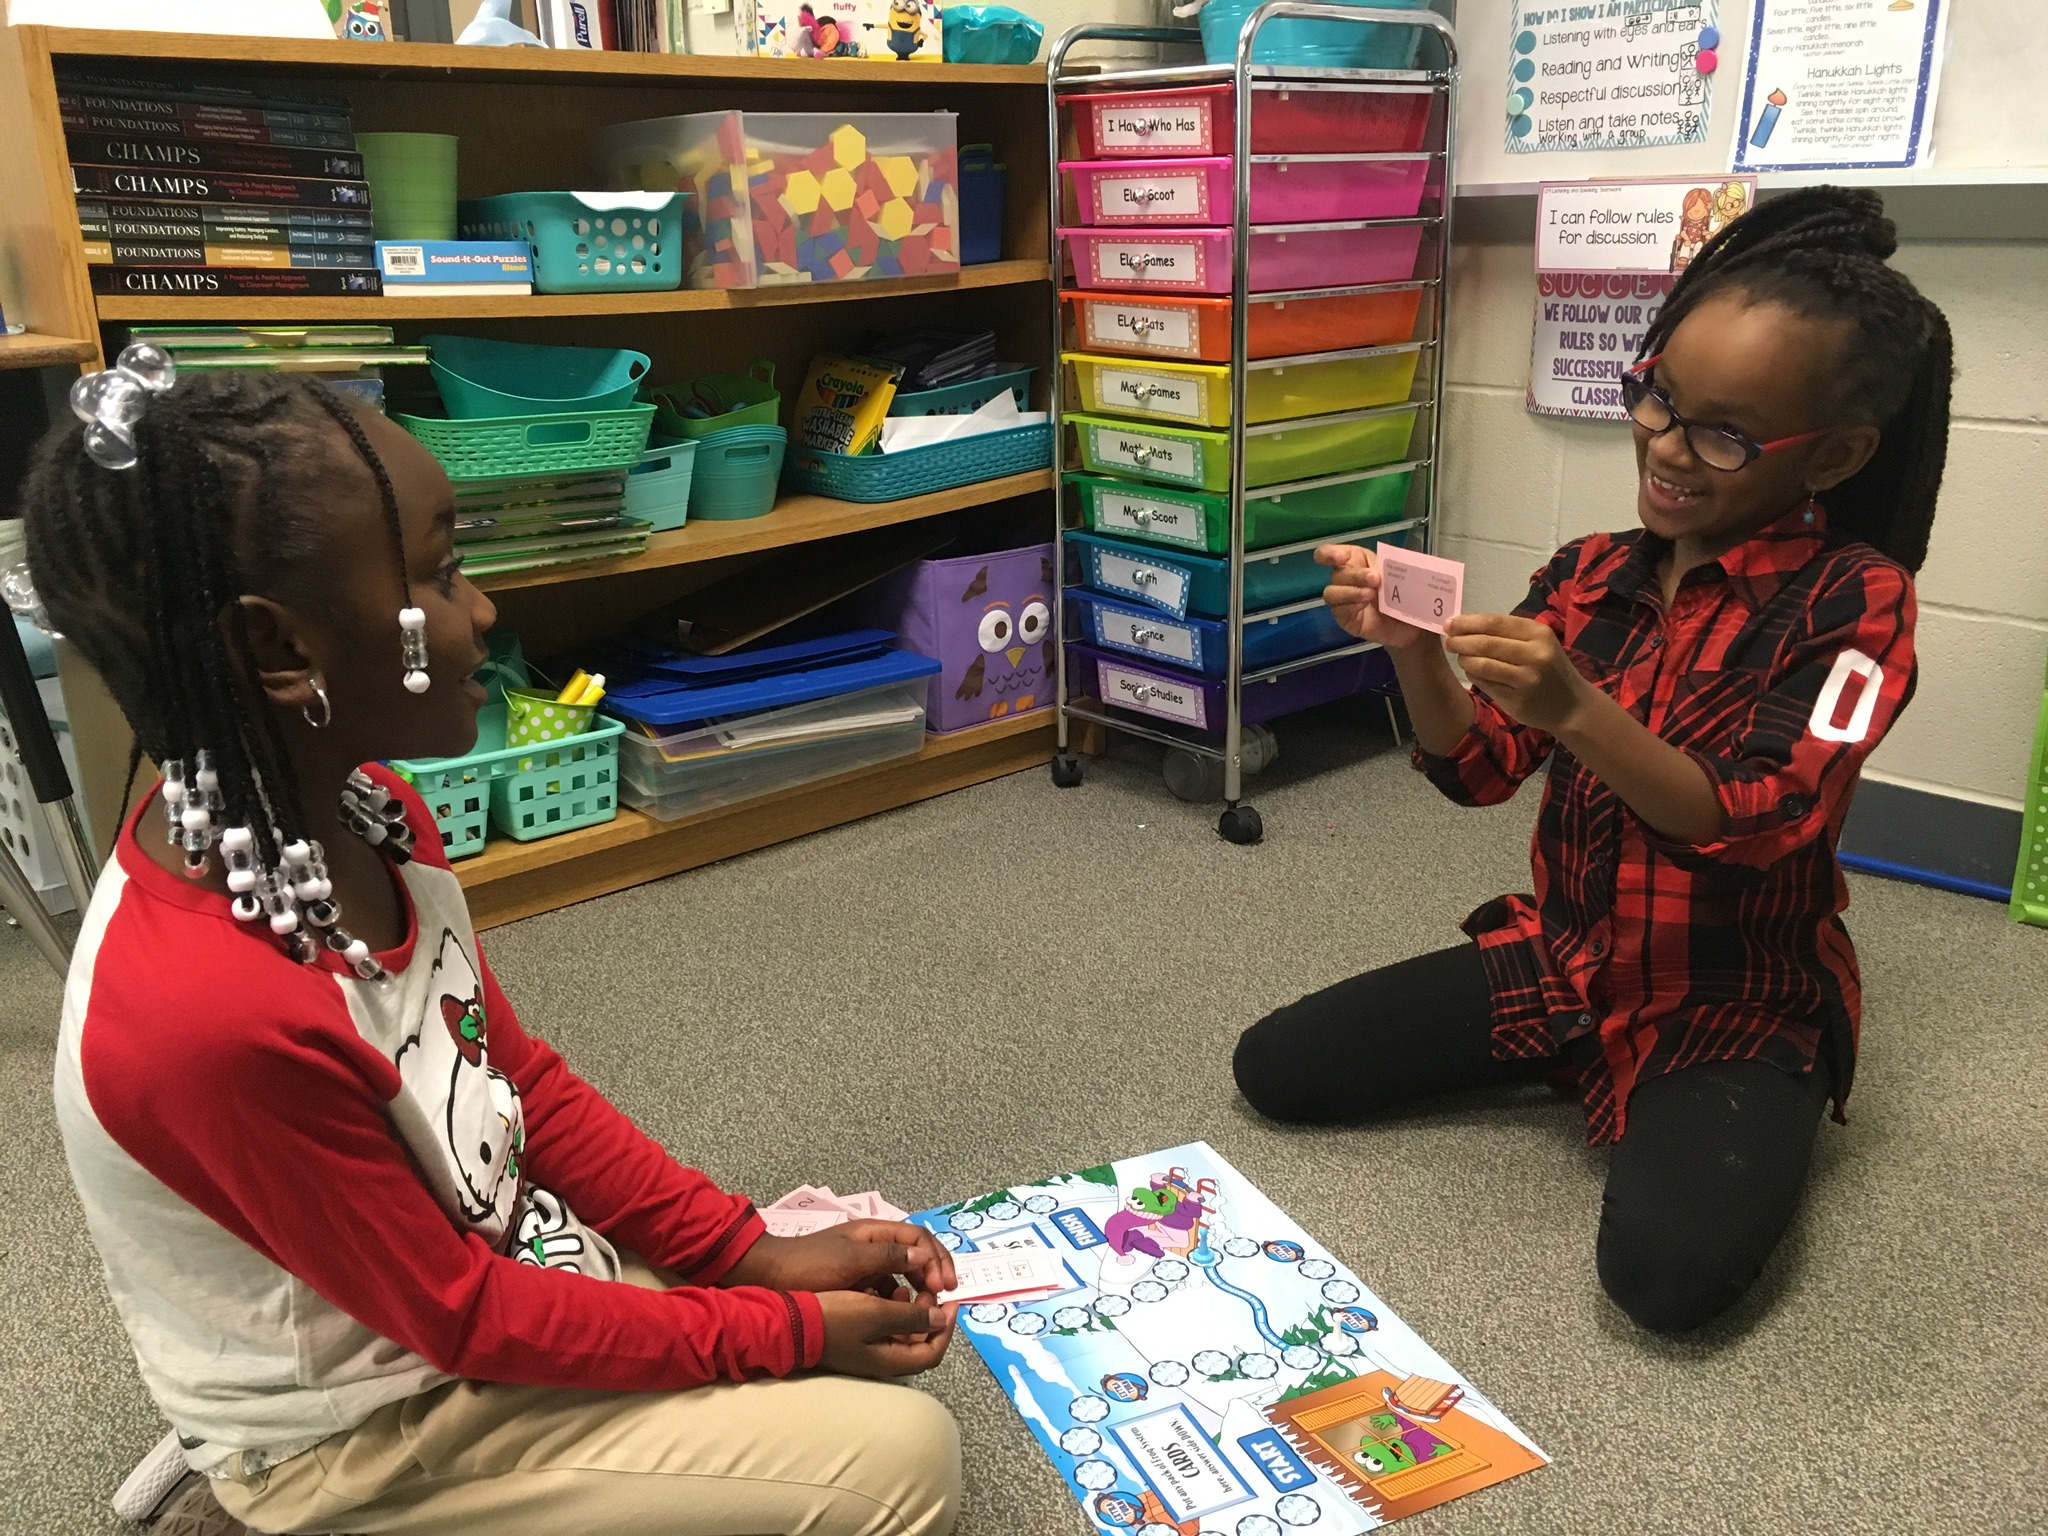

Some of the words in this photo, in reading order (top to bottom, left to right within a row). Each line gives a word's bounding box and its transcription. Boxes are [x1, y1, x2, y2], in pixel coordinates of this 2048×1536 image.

[833, 3, 857, 12] fluffy
[1524, 12, 1545, 26] HOW
[1561, 9, 1566, 22] I
[1569, 6, 1597, 21] SHOW
[1599, 4, 1604, 18] I
[1606, 2, 1622, 17] AM
[575, 6, 588, 43] Purell
[1543, 30, 1590, 47] Listening
[1594, 27, 1617, 40] with
[1620, 23, 1648, 42] eyes
[1652, 19, 1675, 34] and
[1678, 17, 1708, 31] ears
[1796, 42, 1829, 51] Hanukkah
[1542, 62, 1592, 80] Reading
[1596, 56, 1622, 72] and
[1627, 51, 1680, 74] Writing
[1807, 65, 1862, 79] Hanukkah
[1865, 63, 1902, 77] Lights
[1540, 87, 1607, 110] Respectful
[1610, 82, 1681, 99] discussion
[1851, 87, 1886, 95] Hanukkah
[1888, 86, 1908, 95] lights
[85, 97, 173, 114] FOUNDATIONS
[92, 116, 180, 132] FOUNDATIONS
[1108, 120, 1114, 132] I
[1150, 118, 1172, 131] Who
[1176, 118, 1195, 131] Has
[1539, 118, 1576, 133] Listen
[1579, 115, 1604, 131] and
[1608, 113, 1637, 128] take
[1640, 111, 1680, 126] notes
[1866, 115, 1880, 123] and
[1846, 125, 1881, 133] Hanukkah
[1539, 131, 1578, 147] Working
[1583, 129, 1602, 141] with
[1619, 130, 1646, 145] group
[107, 142, 200, 164] CHAMPS
[115, 174, 209, 195] CHAMPS
[112, 205, 199, 219] FOUNDATIONS
[1549, 210, 1557, 225] I
[1561, 212, 1585, 225] can
[1589, 209, 1632, 225] follow
[1637, 208, 1674, 224] rules
[115, 223, 201, 236] FOUNDATIONS
[1559, 231, 1582, 244] for
[1585, 229, 1658, 245] discussion.
[116, 247, 201, 259] FOUNDATIONS
[493, 254, 527, 263] Puzzles
[1143, 253, 1175, 267] Games
[502, 263, 528, 271] Blends
[126, 273, 219, 290] CHAMPS
[1544, 303, 1560, 321] WE
[1562, 304, 1610, 324] FOLLOW
[1614, 305, 1642, 324] OUR
[1559, 331, 1594, 351] RULES
[1598, 333, 1617, 351] SO
[1622, 333, 1645, 352] WE
[1552, 357, 1624, 379] SUCCESSFUL
[821, 373, 865, 395] Crayola
[1149, 384, 1181, 400] Games
[811, 406, 855, 428] ULTRA-CLEAN
[802, 417, 854, 446] WASHABLE
[802, 433, 843, 455] MARKERS
[1149, 446, 1173, 461] Mats
[1151, 510, 1178, 524] Scoot
[1391, 585, 1401, 604] A
[1433, 598, 1444, 616] 3
[1150, 687, 1183, 704] Studies
[798, 1197, 816, 1208] 2
[1058, 1213, 1098, 1246] FINISH
[1131, 1426, 1149, 1449] System
[1186, 1438, 1200, 1455] side
[1158, 1461, 1167, 1471] of
[1162, 1442, 1200, 1478] CARDS
[1198, 1453, 1218, 1475] answer
[1251, 1440, 1301, 1484] START
[1161, 1469, 1179, 1487] pack
[1175, 1484, 1188, 1498] any
[1183, 1497, 1197, 1511] Put
